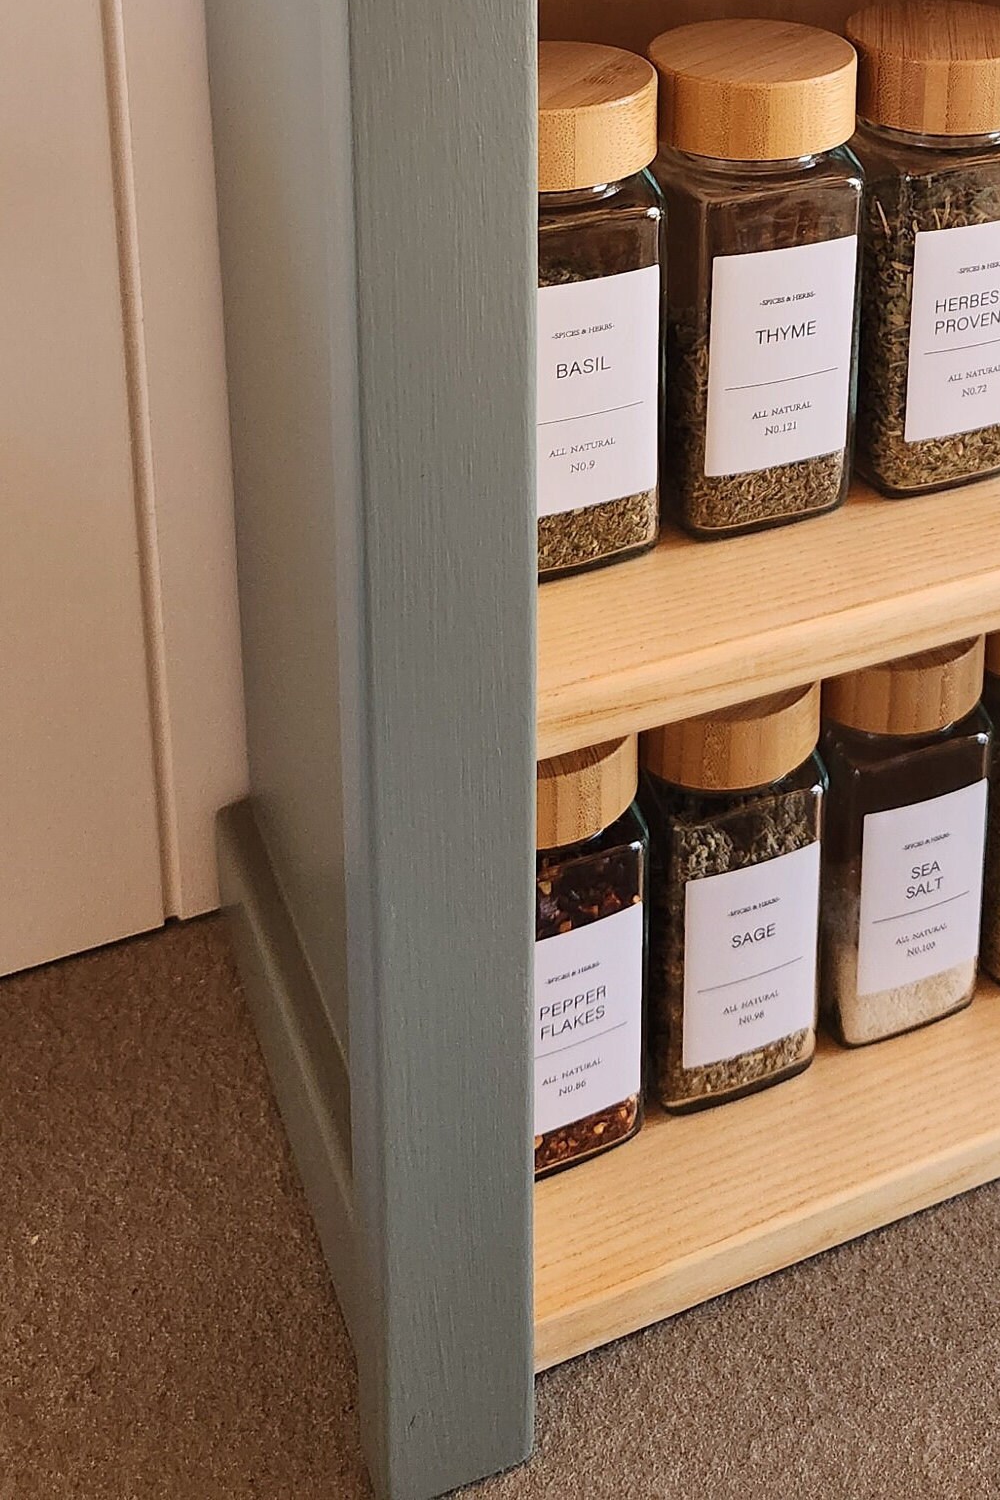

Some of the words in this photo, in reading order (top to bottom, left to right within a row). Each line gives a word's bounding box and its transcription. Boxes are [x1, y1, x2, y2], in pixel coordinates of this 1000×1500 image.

[935, 290, 999, 314] HERBES
[755, 319, 817, 345] THYME
[556, 355, 611, 379] BASIL
[948, 372, 963, 383] ALL
[752, 410, 768, 420] ALL
[771, 401, 812, 416] NATURAL
[549, 448, 567, 458] ALL
[570, 437, 616, 454] NATURAL
[911, 861, 940, 880] SEA
[906, 877, 944, 900] SALT
[731, 923, 776, 948] SAGE
[539, 985, 606, 1021] PEPPER
[540, 1005, 606, 1041] FLAKES
[542, 1074, 558, 1086] ALL
[561, 1058, 602, 1080] NATURAL
